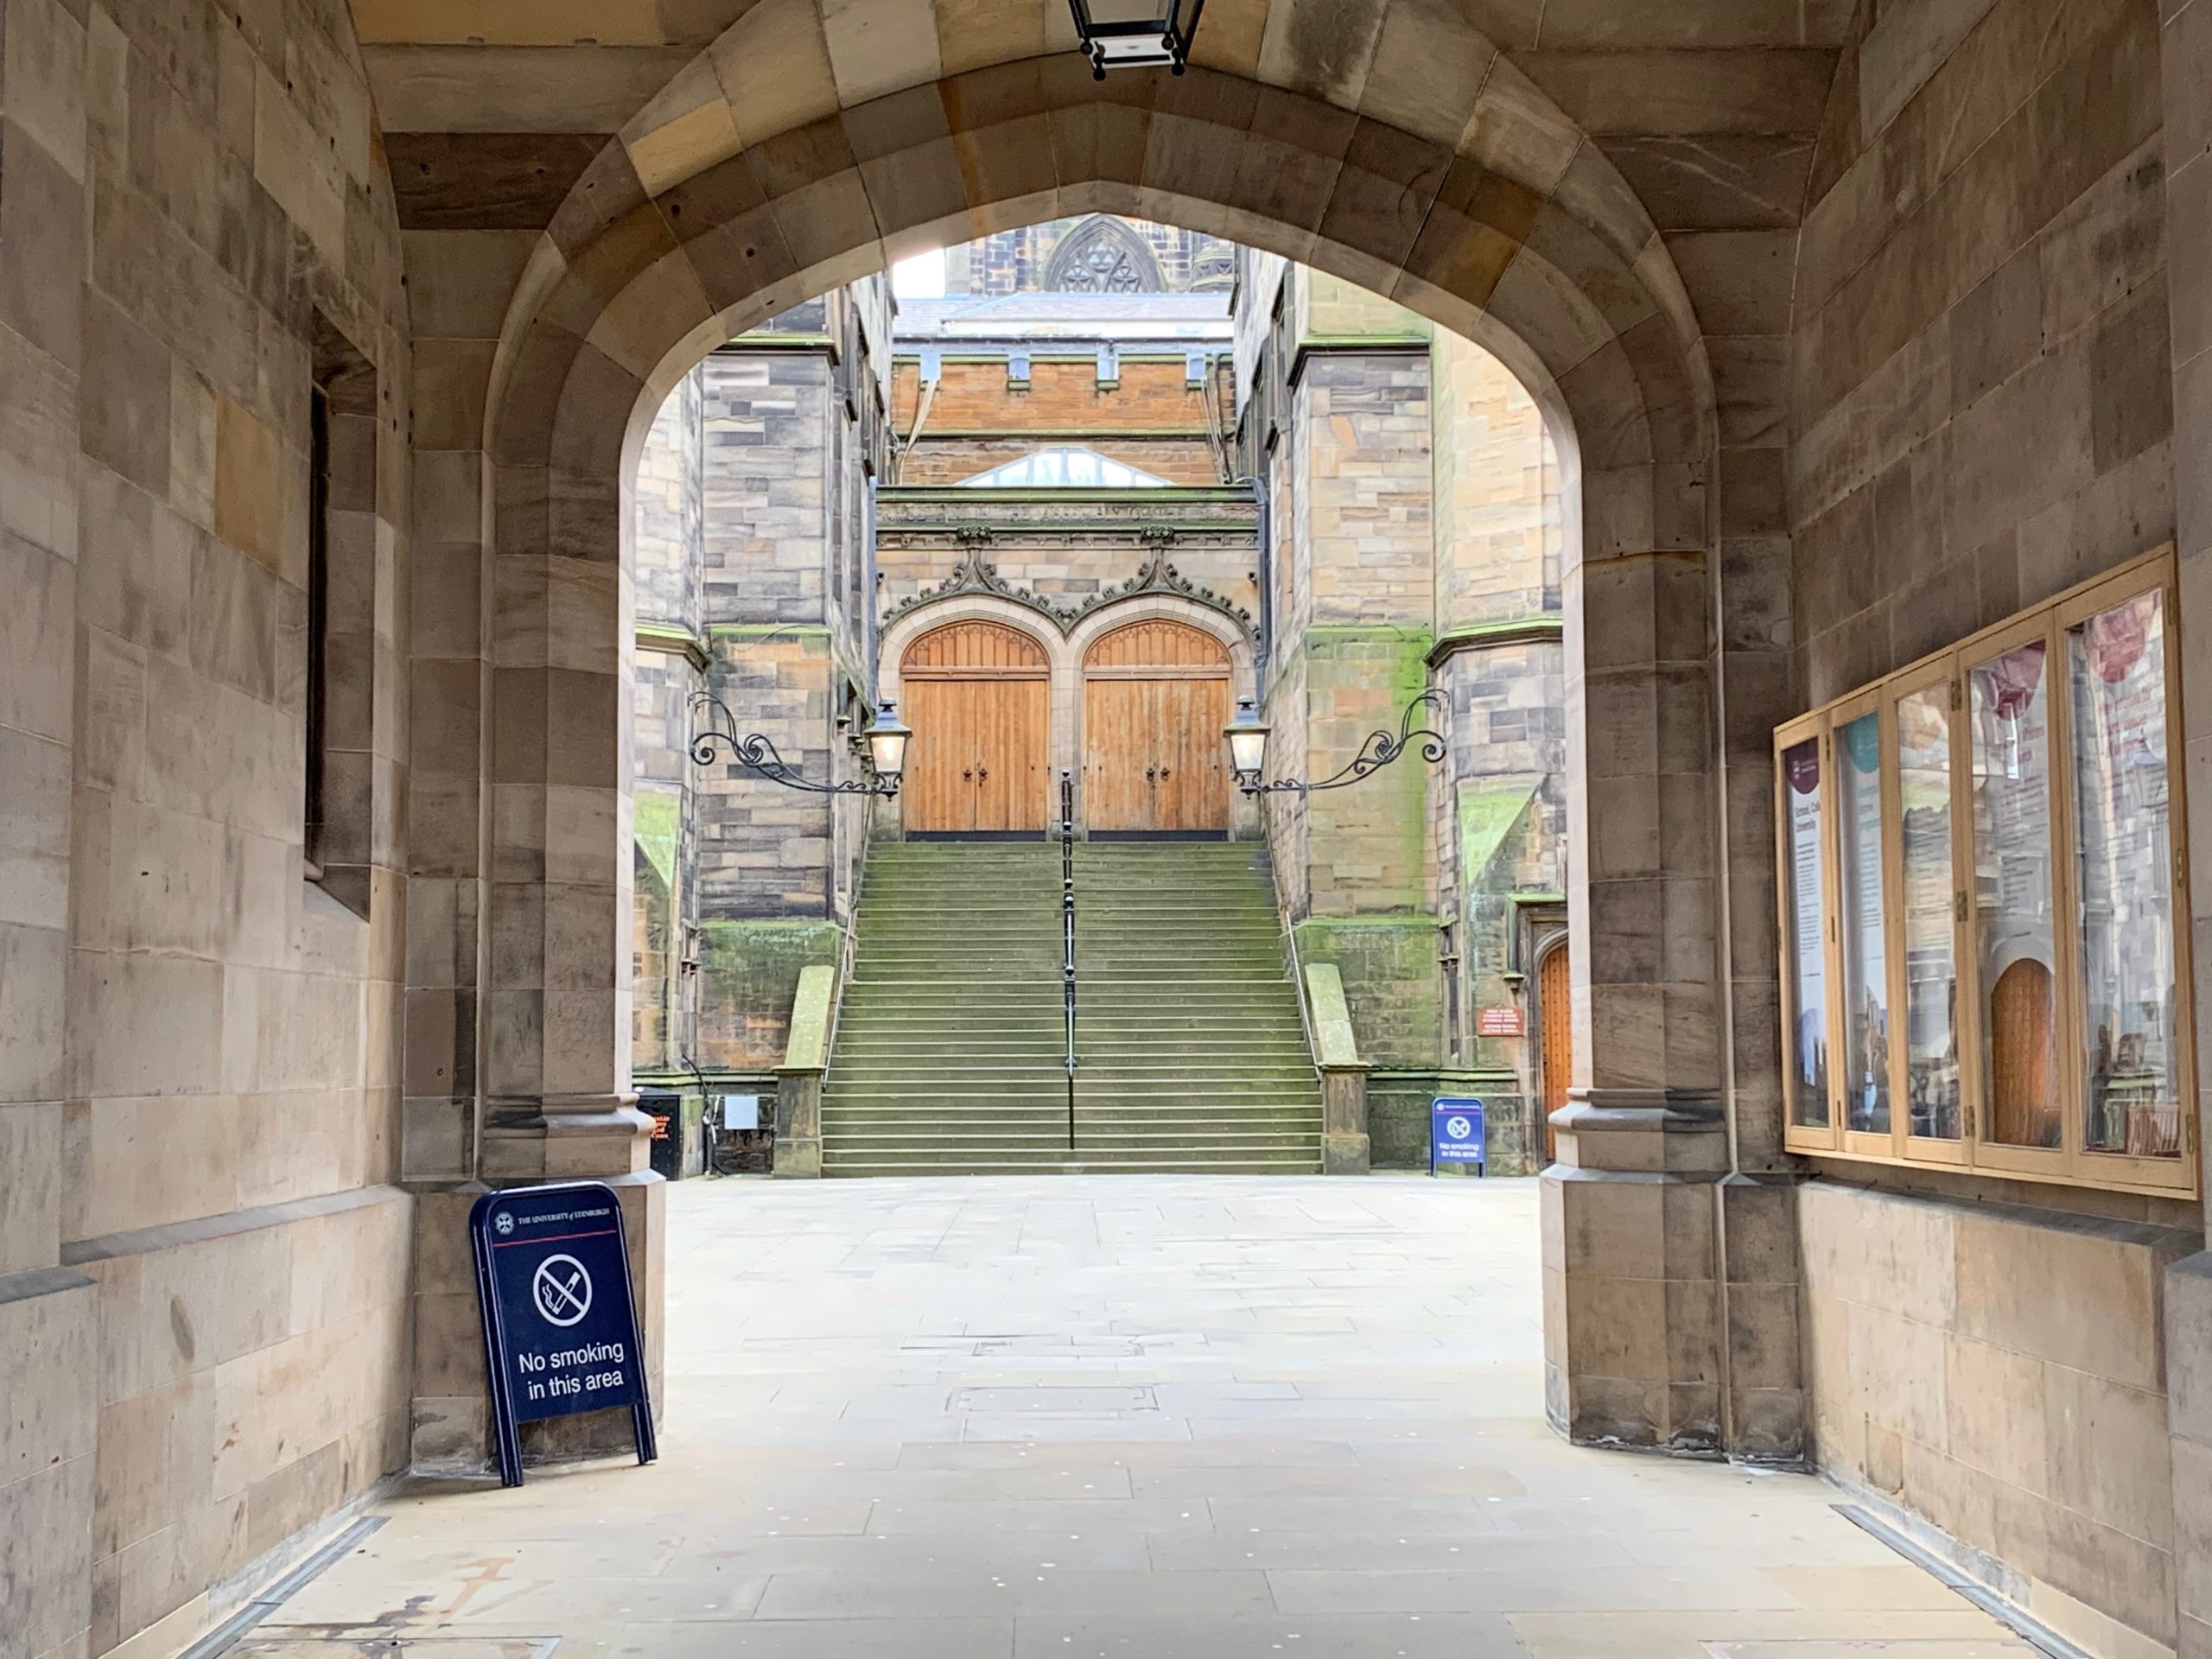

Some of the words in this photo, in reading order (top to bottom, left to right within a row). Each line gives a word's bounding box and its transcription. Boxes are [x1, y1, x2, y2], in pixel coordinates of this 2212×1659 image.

[1451, 1142, 1479, 1152] smoking
[518, 1217, 531, 1225] THE
[531, 1211, 569, 1224] UNIVERSITY
[569, 1211, 575, 1221] of
[575, 1208, 610, 1219] EDINBURGH
[518, 1352, 546, 1374] No
[550, 1342, 624, 1369] smoking
[528, 1381, 546, 1401] in
[549, 1374, 582, 1397] this
[585, 1370, 624, 1391] area
